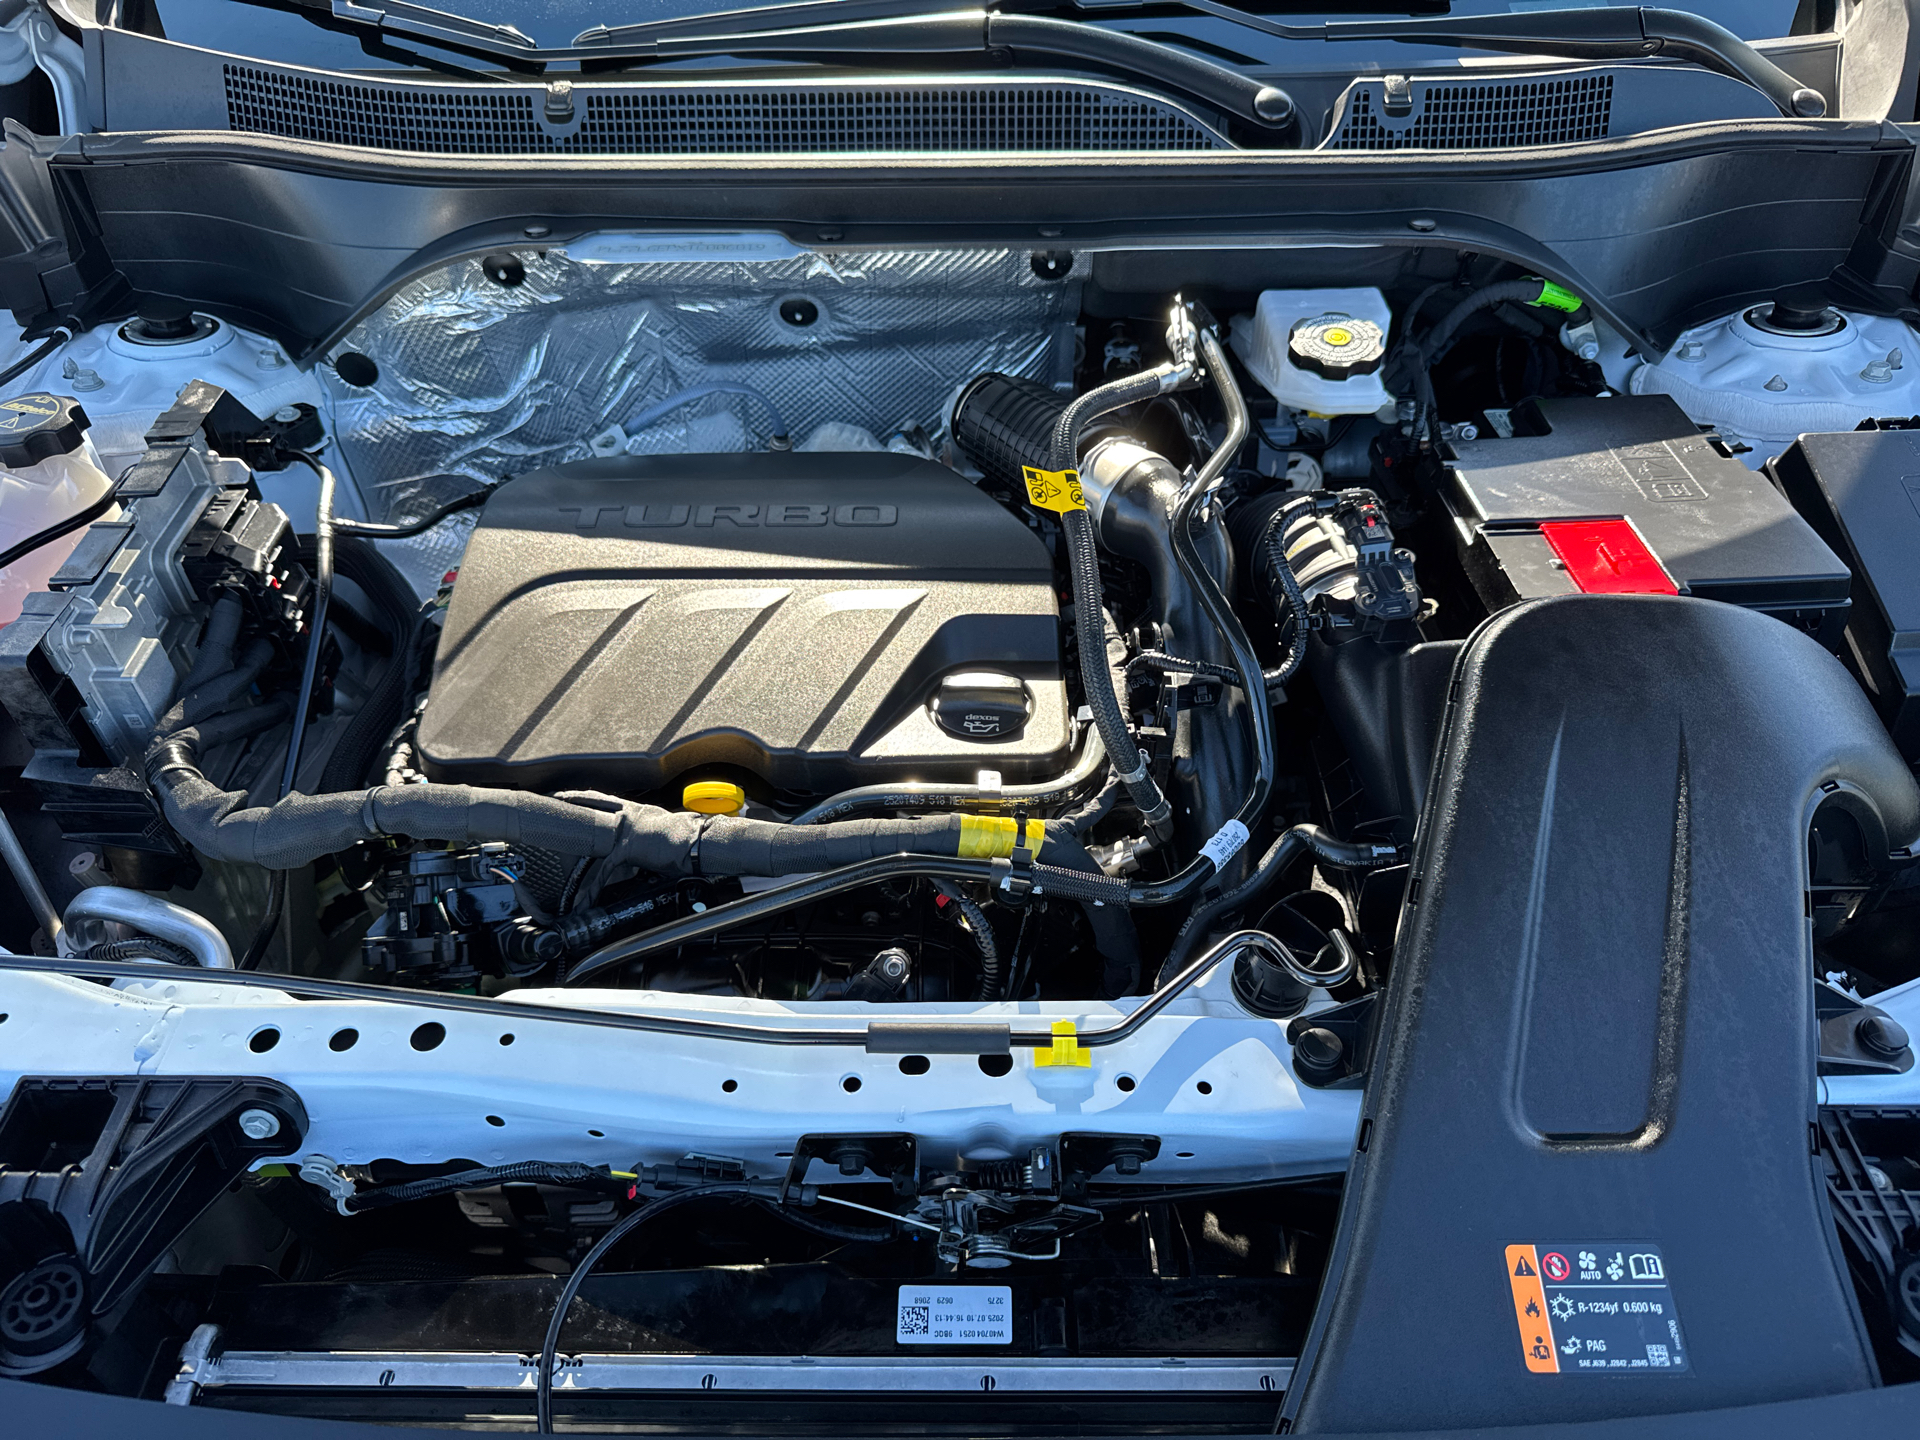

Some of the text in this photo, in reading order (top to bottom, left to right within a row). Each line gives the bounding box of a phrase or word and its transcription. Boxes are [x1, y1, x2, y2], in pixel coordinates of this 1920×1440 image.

[558, 504, 898, 528] TURBO
[965, 713, 1000, 721] dexos
[949, 795, 966, 806] MEX
[1331, 856, 1384, 866] SLOVAKIA
[1580, 1270, 1602, 1281] AUTO
[914, 1296, 1004, 1305] 3275 0629 2068
[1577, 1302, 1663, 1316] R-1234yf 0.600 kg
[934, 1314, 1004, 1322] 2025.07.10 16:44:13
[1586, 1340, 1607, 1352] PAG
[1578, 1359, 1591, 1368] SAE
